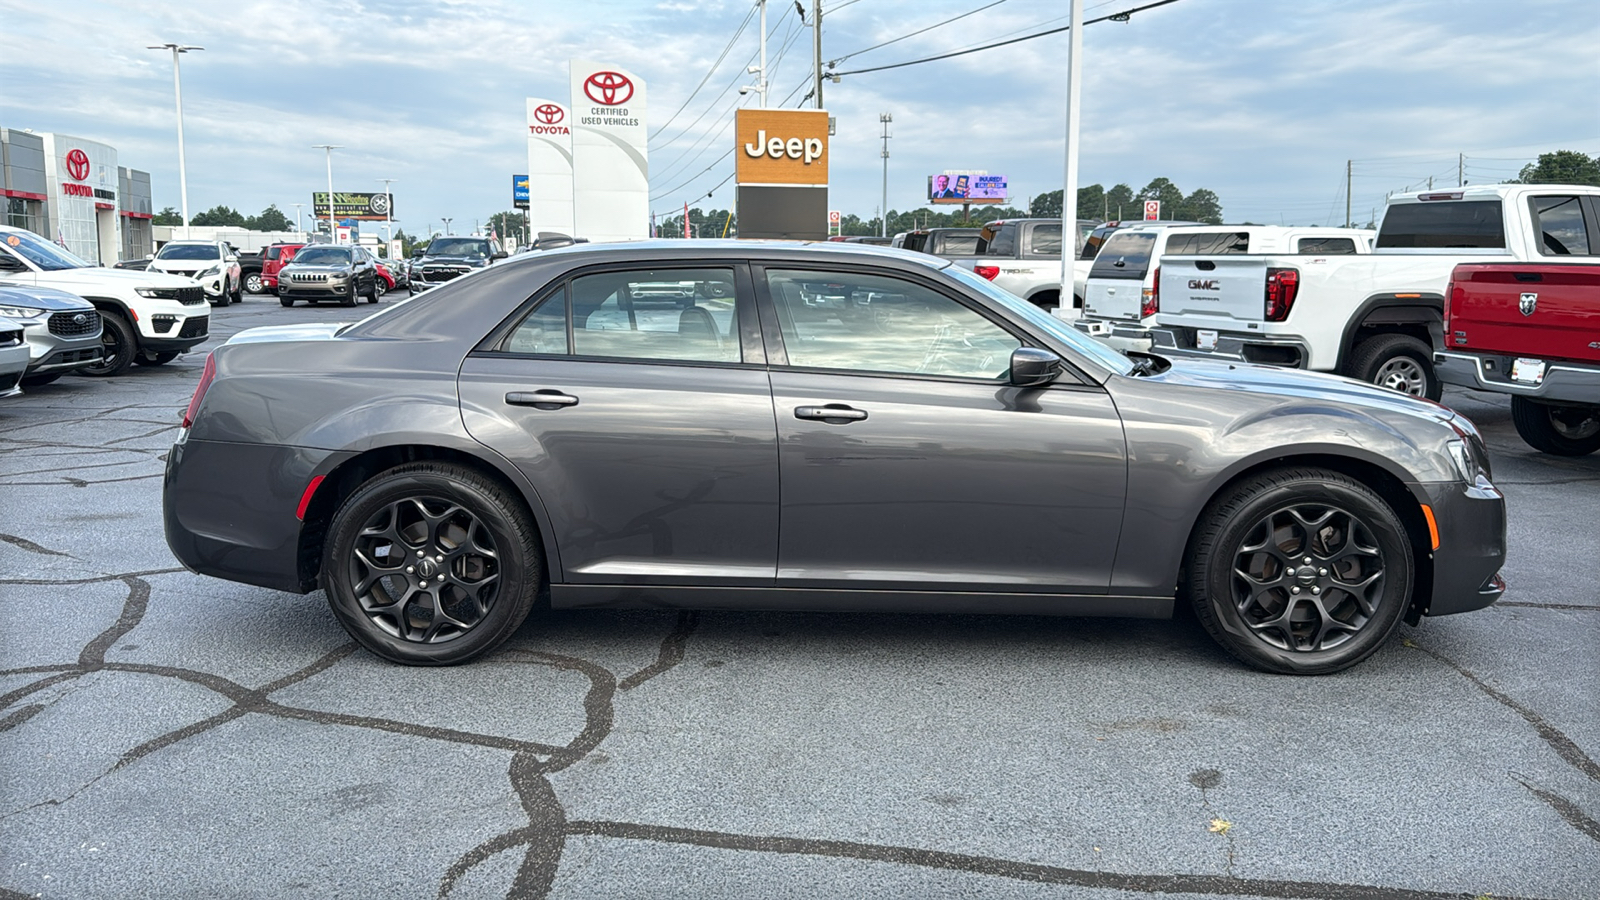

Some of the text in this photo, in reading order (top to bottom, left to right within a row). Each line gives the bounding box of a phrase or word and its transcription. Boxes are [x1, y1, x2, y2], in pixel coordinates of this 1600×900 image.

[591, 107, 629, 116] CERTIFIED
[581, 117, 639, 127] USED VEHICLES
[529, 125, 570, 135] TOYOTA
[745, 129, 823, 165] Jeep
[62, 183, 93, 198] TOYOTA
[1188, 279, 1220, 290] GMC
